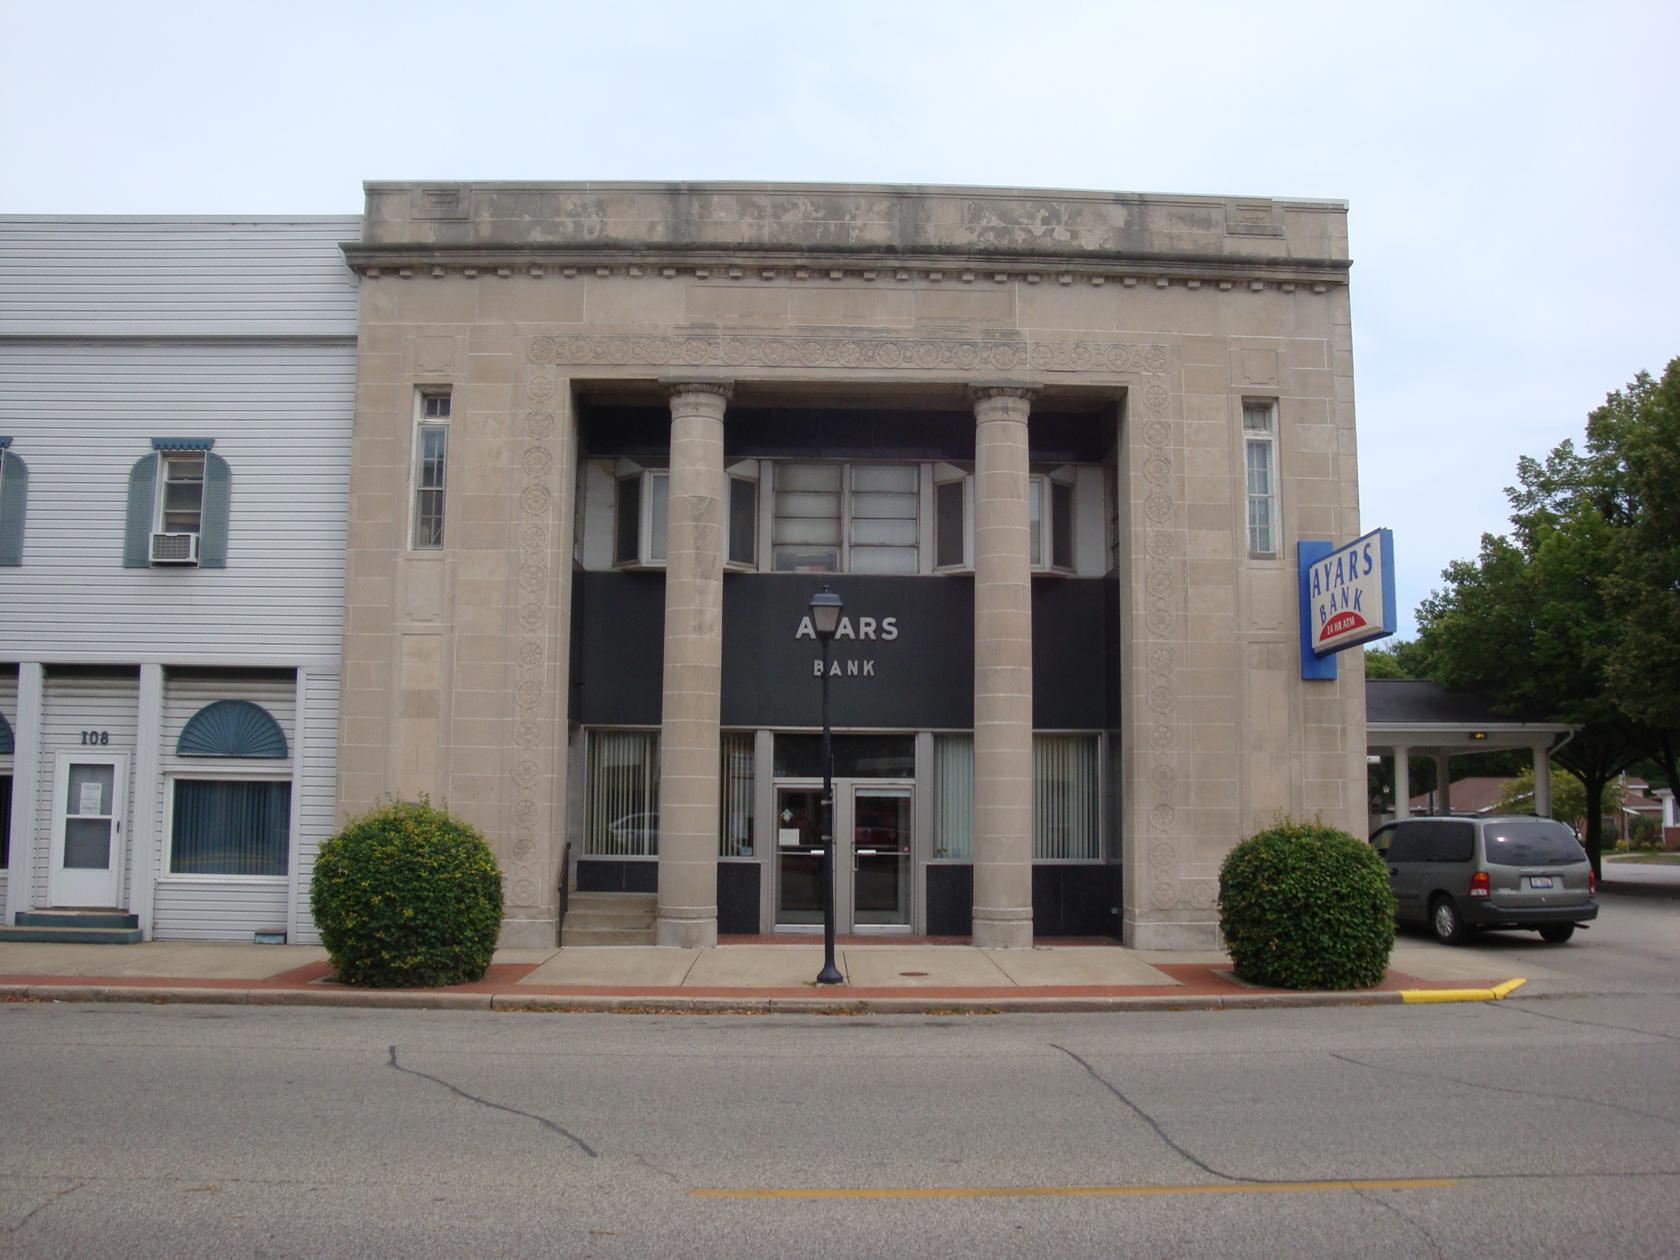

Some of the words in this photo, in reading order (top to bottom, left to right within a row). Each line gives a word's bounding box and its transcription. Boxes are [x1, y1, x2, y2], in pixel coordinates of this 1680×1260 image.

[1312, 542, 1373, 598] AYARS
[1319, 586, 1363, 626] BANK
[795, 616, 898, 641] AARS
[1326, 624, 1334, 635] 24
[1334, 620, 1342, 633] HR
[1342, 616, 1356, 629] ATM
[813, 660, 875, 677] BANK
[81, 731, 109, 745] 108
